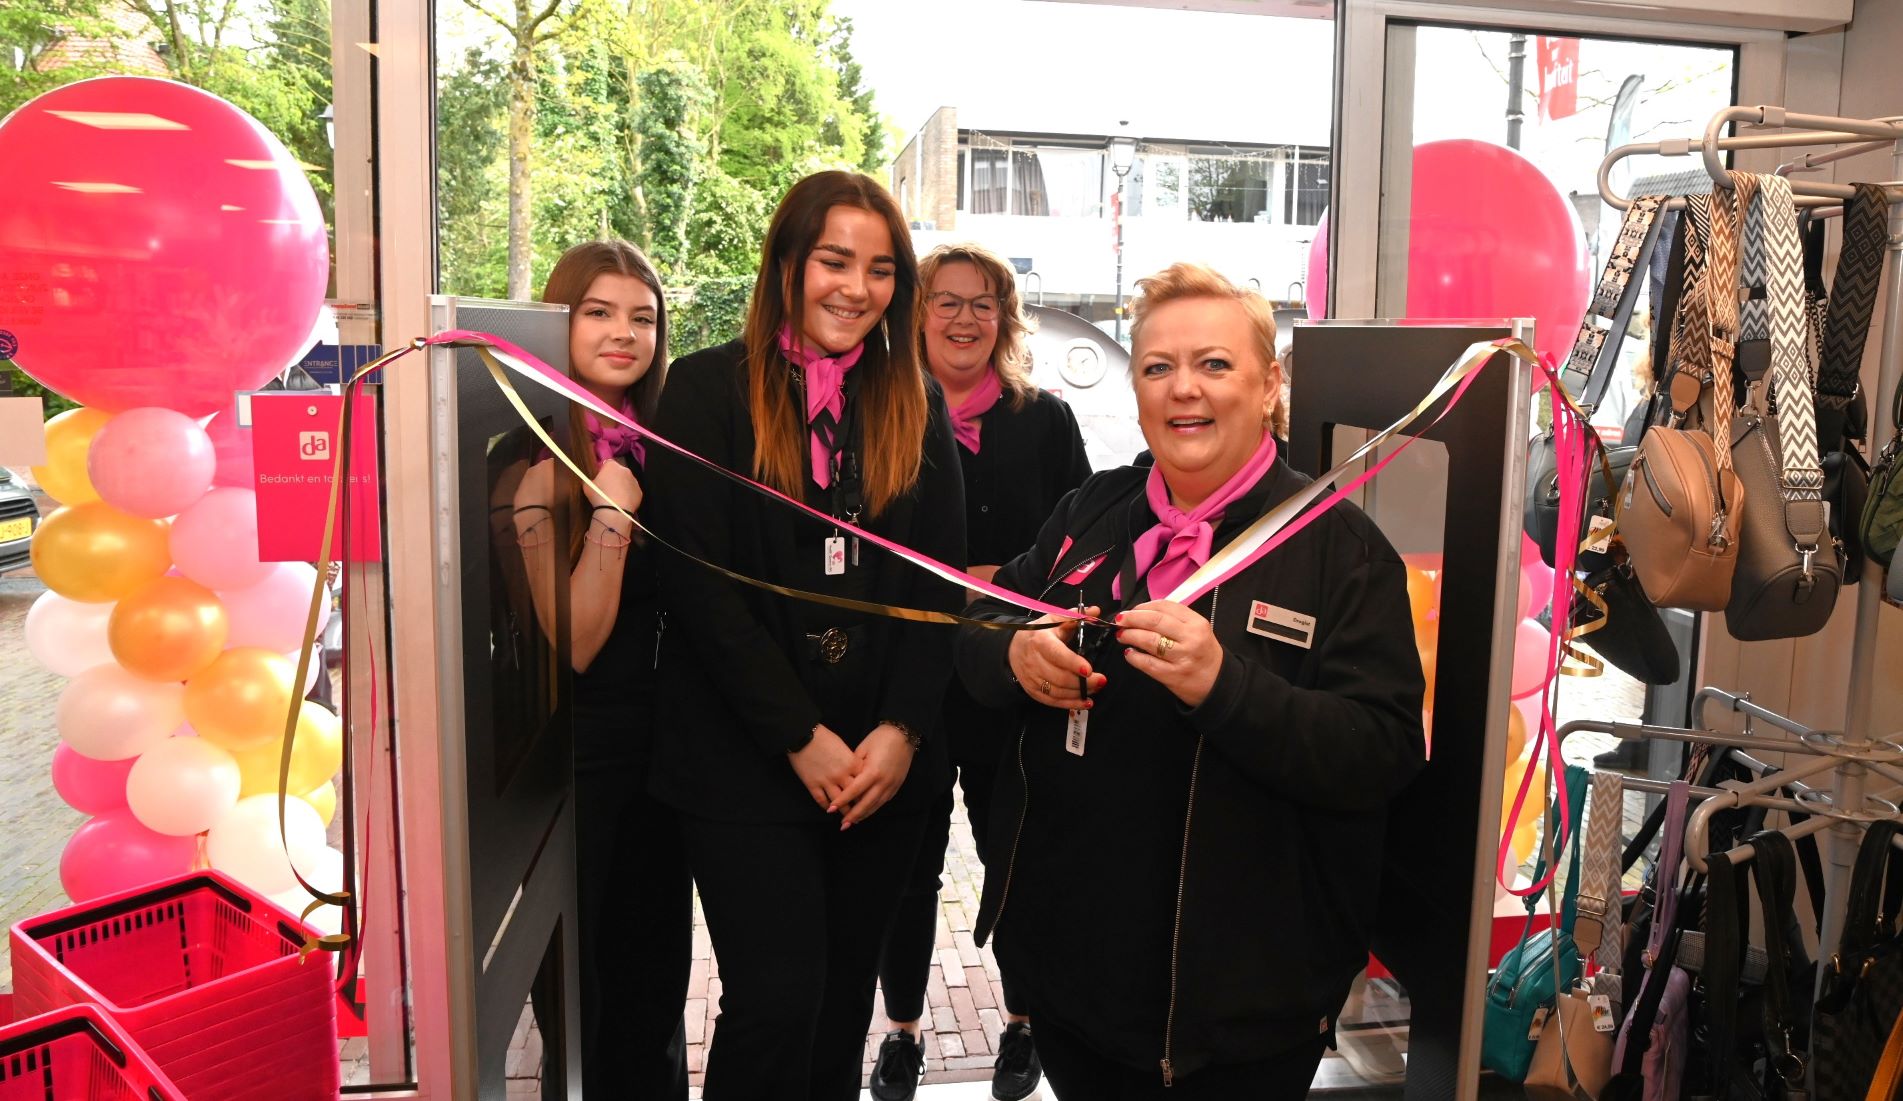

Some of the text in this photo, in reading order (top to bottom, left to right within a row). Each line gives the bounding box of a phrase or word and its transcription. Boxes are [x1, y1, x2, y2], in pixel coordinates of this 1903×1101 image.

[302, 435, 327, 456] da
[260, 474, 304, 484] Bedankt
[307, 476, 321, 484] en
